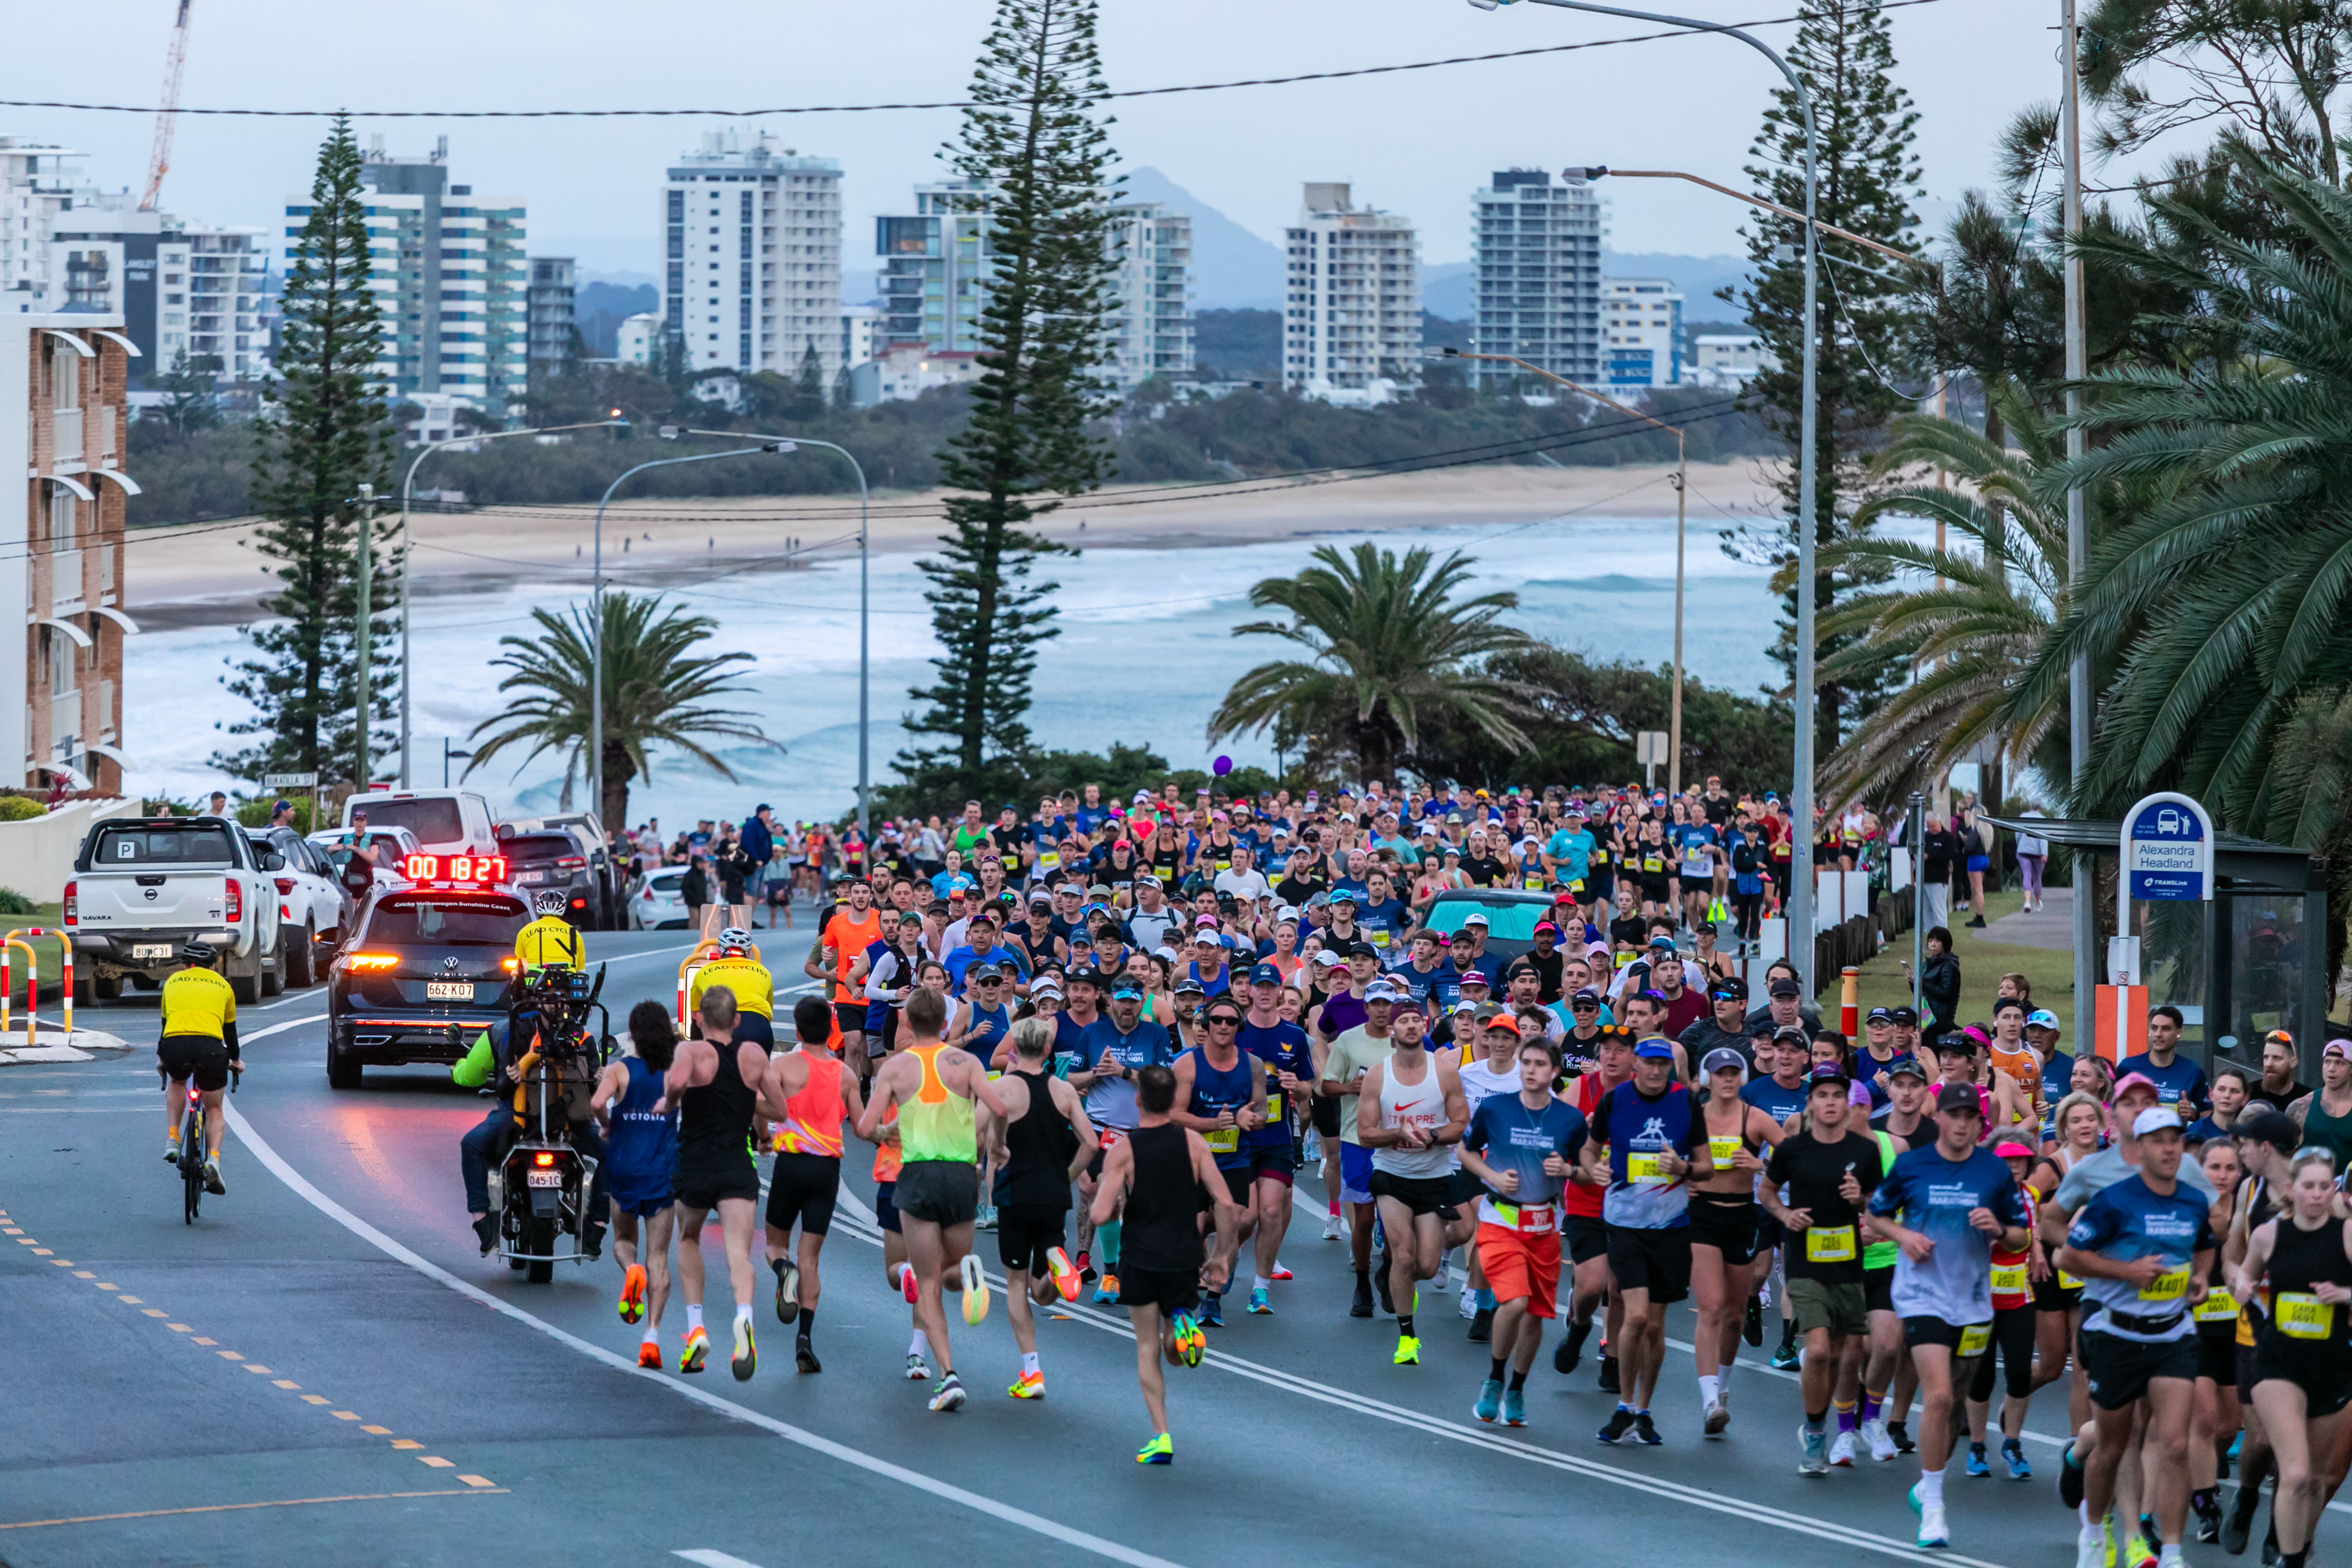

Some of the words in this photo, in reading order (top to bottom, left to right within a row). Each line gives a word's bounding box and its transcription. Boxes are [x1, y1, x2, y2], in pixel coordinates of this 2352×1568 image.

[121, 844, 131, 857] P
[2139, 844, 2195, 856] Alexandra
[409, 856, 436, 880] 00
[451, 858, 471, 880] 18
[476, 858, 505, 881] 27
[2140, 857, 2193, 869] Headland
[526, 926, 546, 938] LEAD
[549, 926, 569, 935] CYCL
[704, 965, 729, 976] LEAD
[732, 965, 767, 979] CYCLIST
[194, 977, 226, 989] CYCLIST
[622, 1113, 666, 1122] VCTORIA
[1416, 1114, 1436, 1124] PRE
